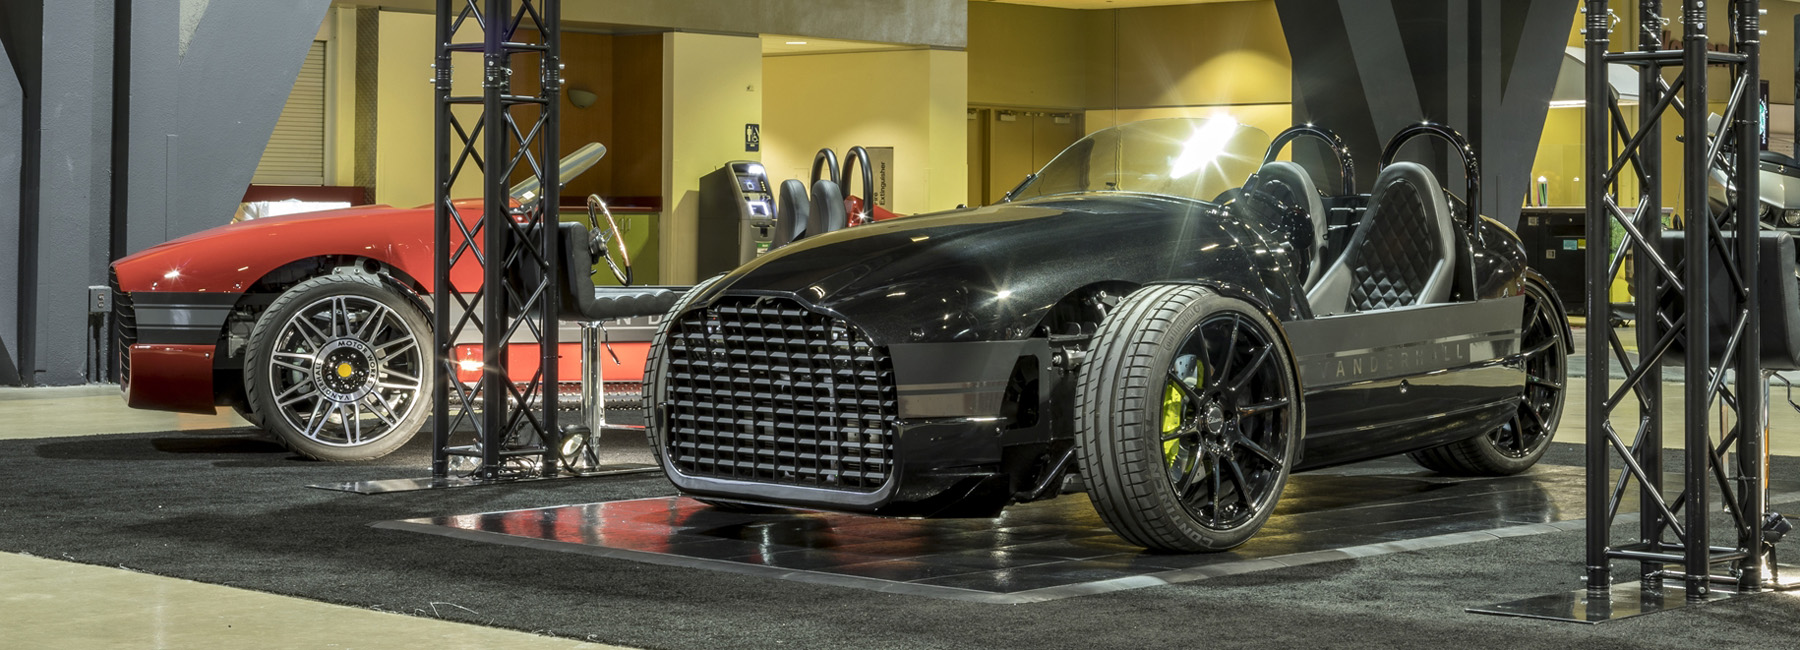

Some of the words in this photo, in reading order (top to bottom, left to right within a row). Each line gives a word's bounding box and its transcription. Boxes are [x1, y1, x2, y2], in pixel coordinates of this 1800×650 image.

[315, 362, 350, 400] VANDERHALL
[338, 340, 368, 354] MOTOR
[367, 354, 377, 384] WORKS
